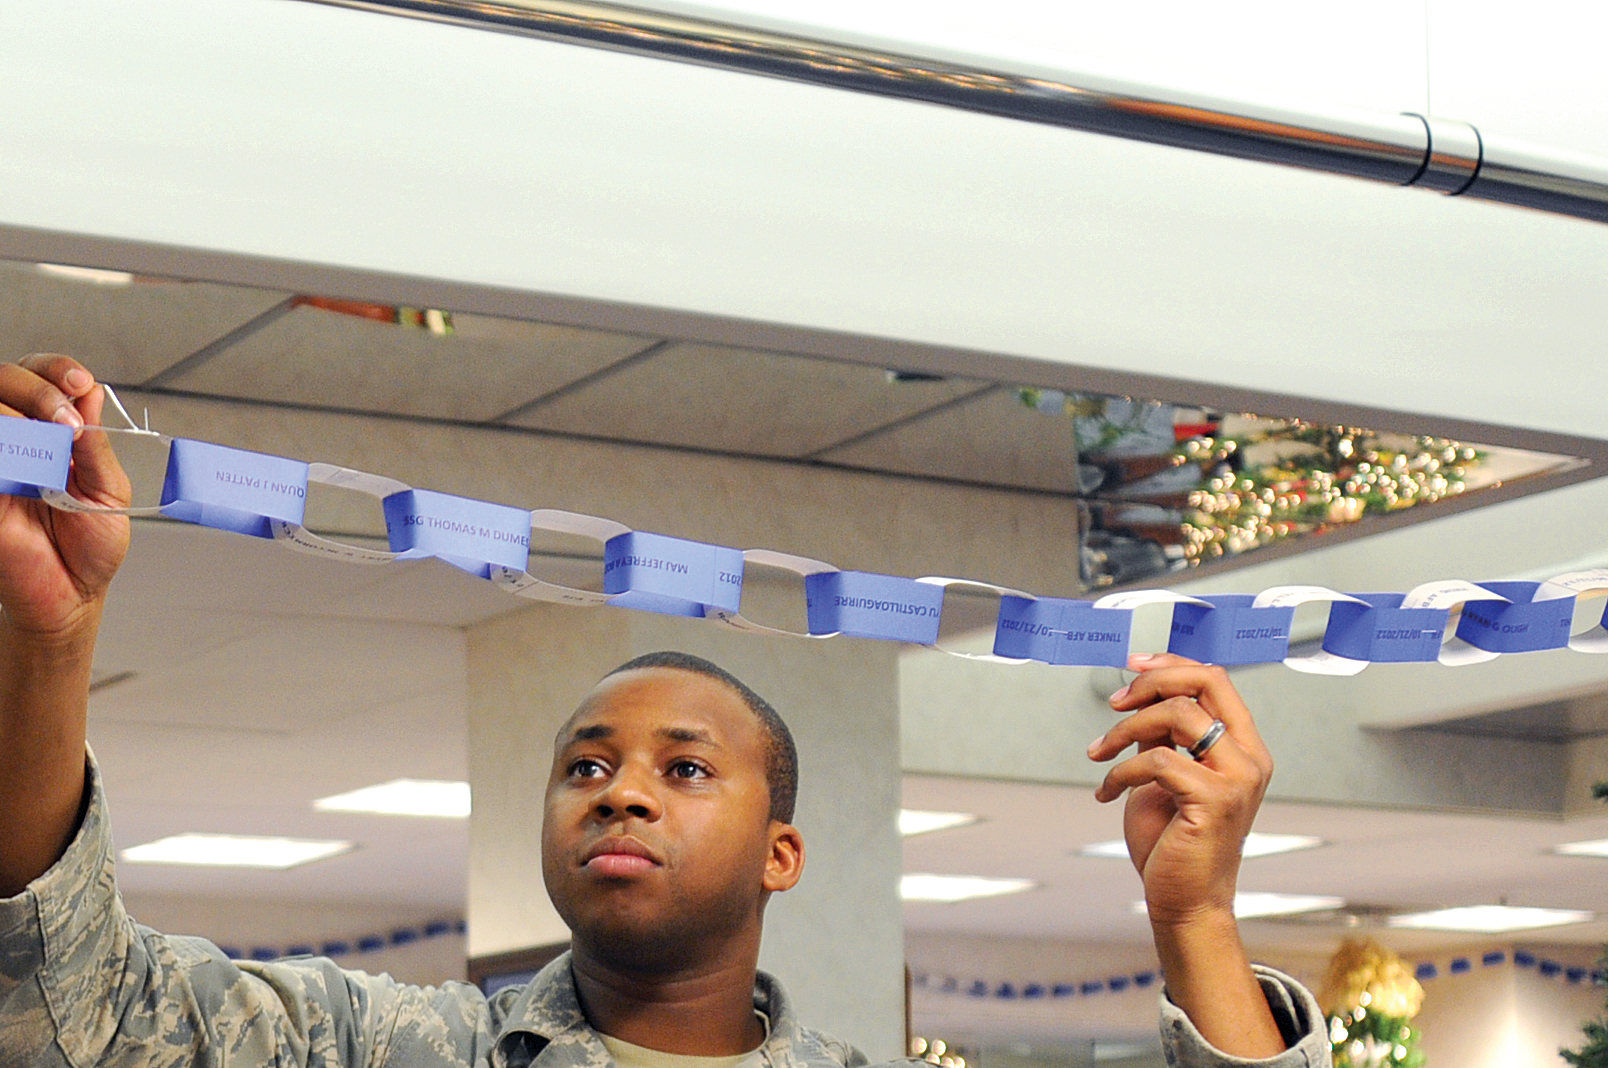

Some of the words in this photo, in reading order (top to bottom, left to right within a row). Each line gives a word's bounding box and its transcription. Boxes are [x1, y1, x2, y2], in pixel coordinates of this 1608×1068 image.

[7, 443, 54, 462] STABEN
[216, 469, 260, 488] PATTEN
[403, 514, 424, 527] SSG
[427, 515, 477, 536] THOMAS
[479, 527, 491, 539] M
[621, 555, 664, 571] JEFFREY
[666, 561, 689, 575] MAJ
[834, 595, 927, 618] CASTILLOAGUIRRE
[1001, 618, 1054, 637] 10/21/2012
[1235, 627, 1283, 640] 10/21/2012
[1375, 629, 1421, 640] 10/21/2012
[1066, 630, 1086, 642] AFB
[1087, 631, 1122, 643] TINKER
